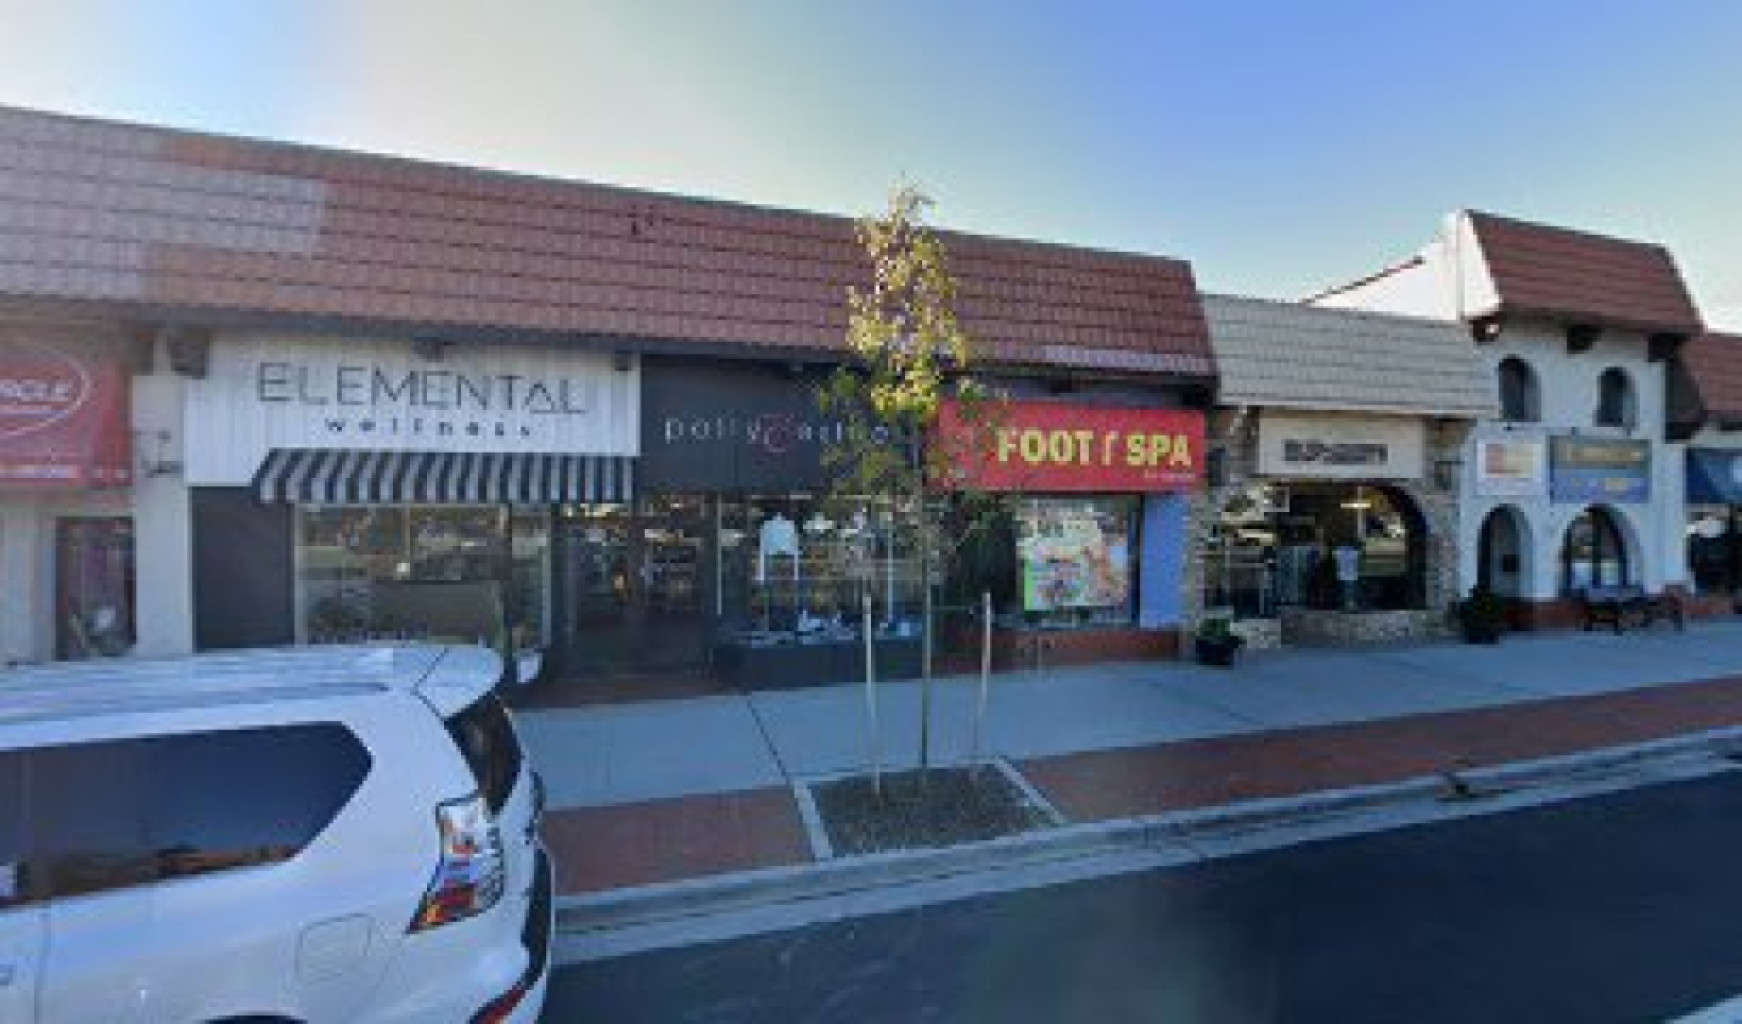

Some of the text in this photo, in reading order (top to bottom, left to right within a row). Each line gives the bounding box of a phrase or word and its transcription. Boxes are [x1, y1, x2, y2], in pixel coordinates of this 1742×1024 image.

[256, 361, 587, 415] ELEMENTAL
[324, 416, 532, 438] wellness
[997, 426, 1095, 466] FOOT
[1125, 433, 1193, 468] SPA
